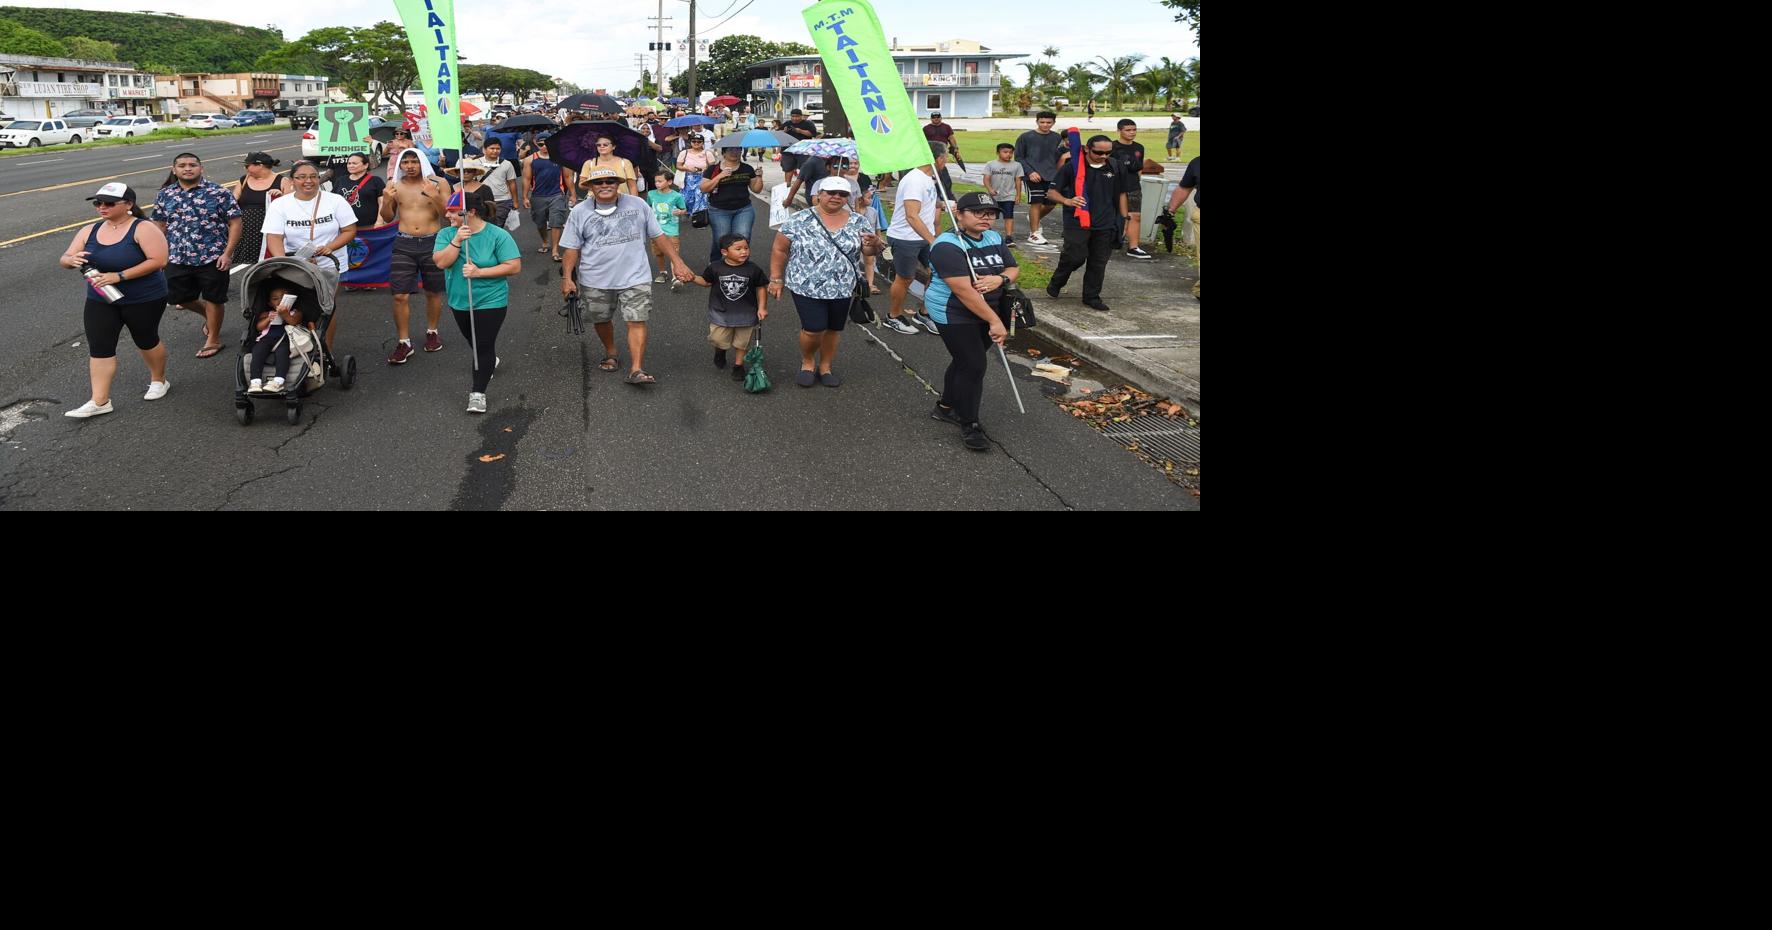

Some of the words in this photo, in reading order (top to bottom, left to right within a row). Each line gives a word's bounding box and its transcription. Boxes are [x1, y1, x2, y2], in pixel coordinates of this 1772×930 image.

[813, 7, 855, 31] M.T.M
[34, 83, 55, 94] LUJAN
[56, 84, 71, 93] TIRE
[73, 84, 89, 93] SHOP
